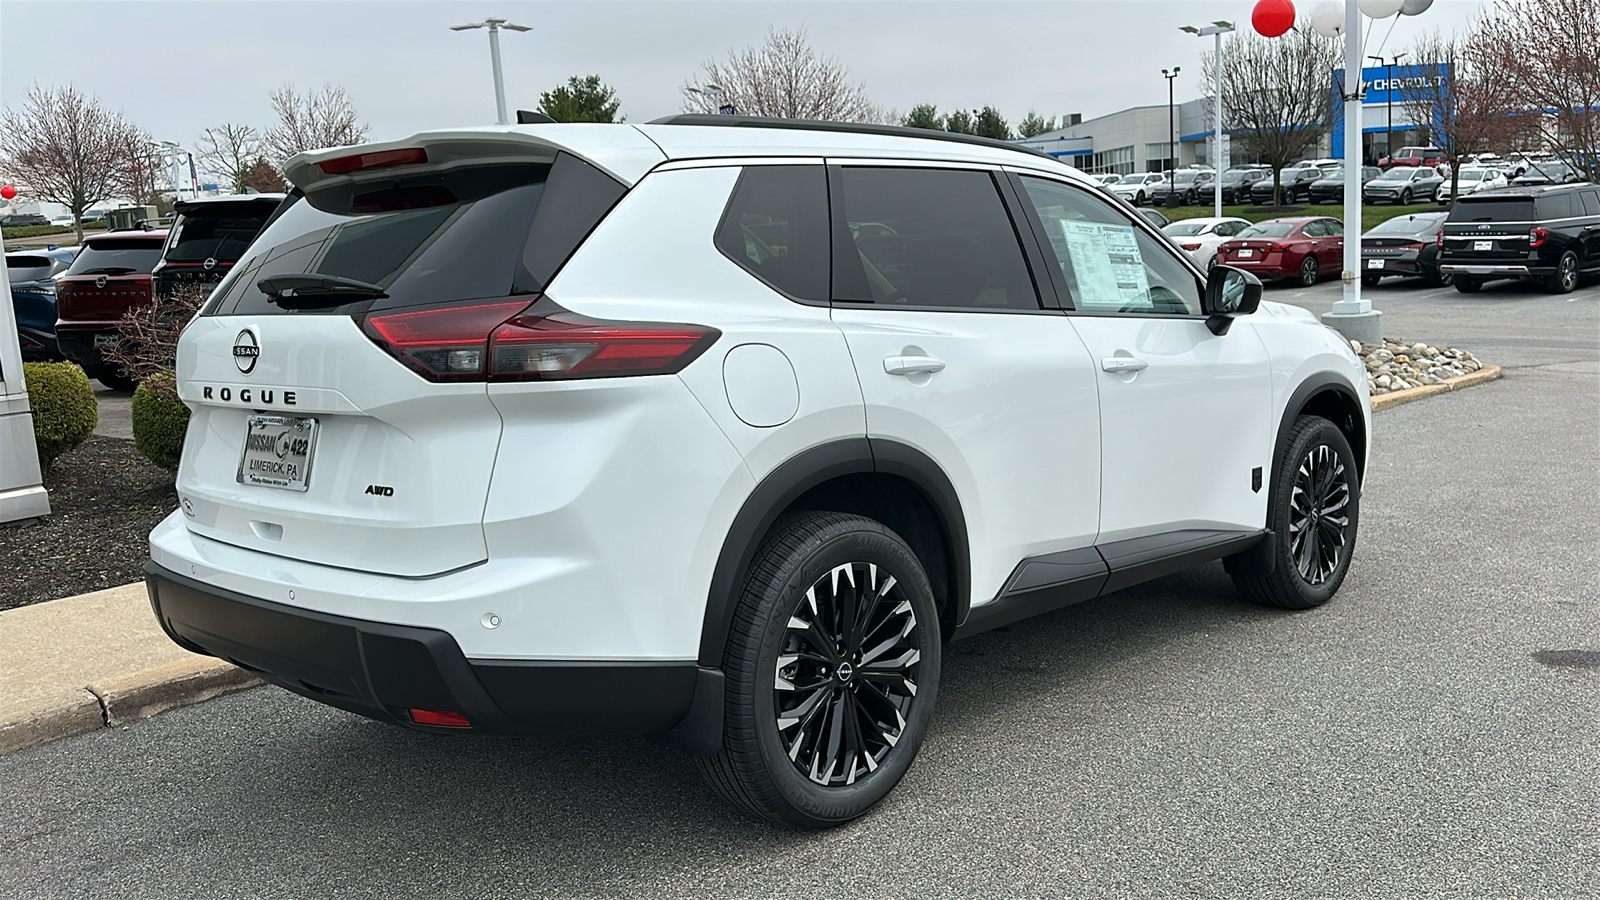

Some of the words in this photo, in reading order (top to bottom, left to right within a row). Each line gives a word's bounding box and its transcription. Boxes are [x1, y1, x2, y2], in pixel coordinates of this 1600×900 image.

[1374, 76, 1442, 90] CHEVROLT
[203, 386, 297, 405] ROGUE
[248, 433, 276, 452] NISSAN
[290, 438, 309, 456] 422
[250, 459, 285, 475] LIMERICK,
[287, 464, 297, 475] PA
[365, 485, 394, 496] AWD
